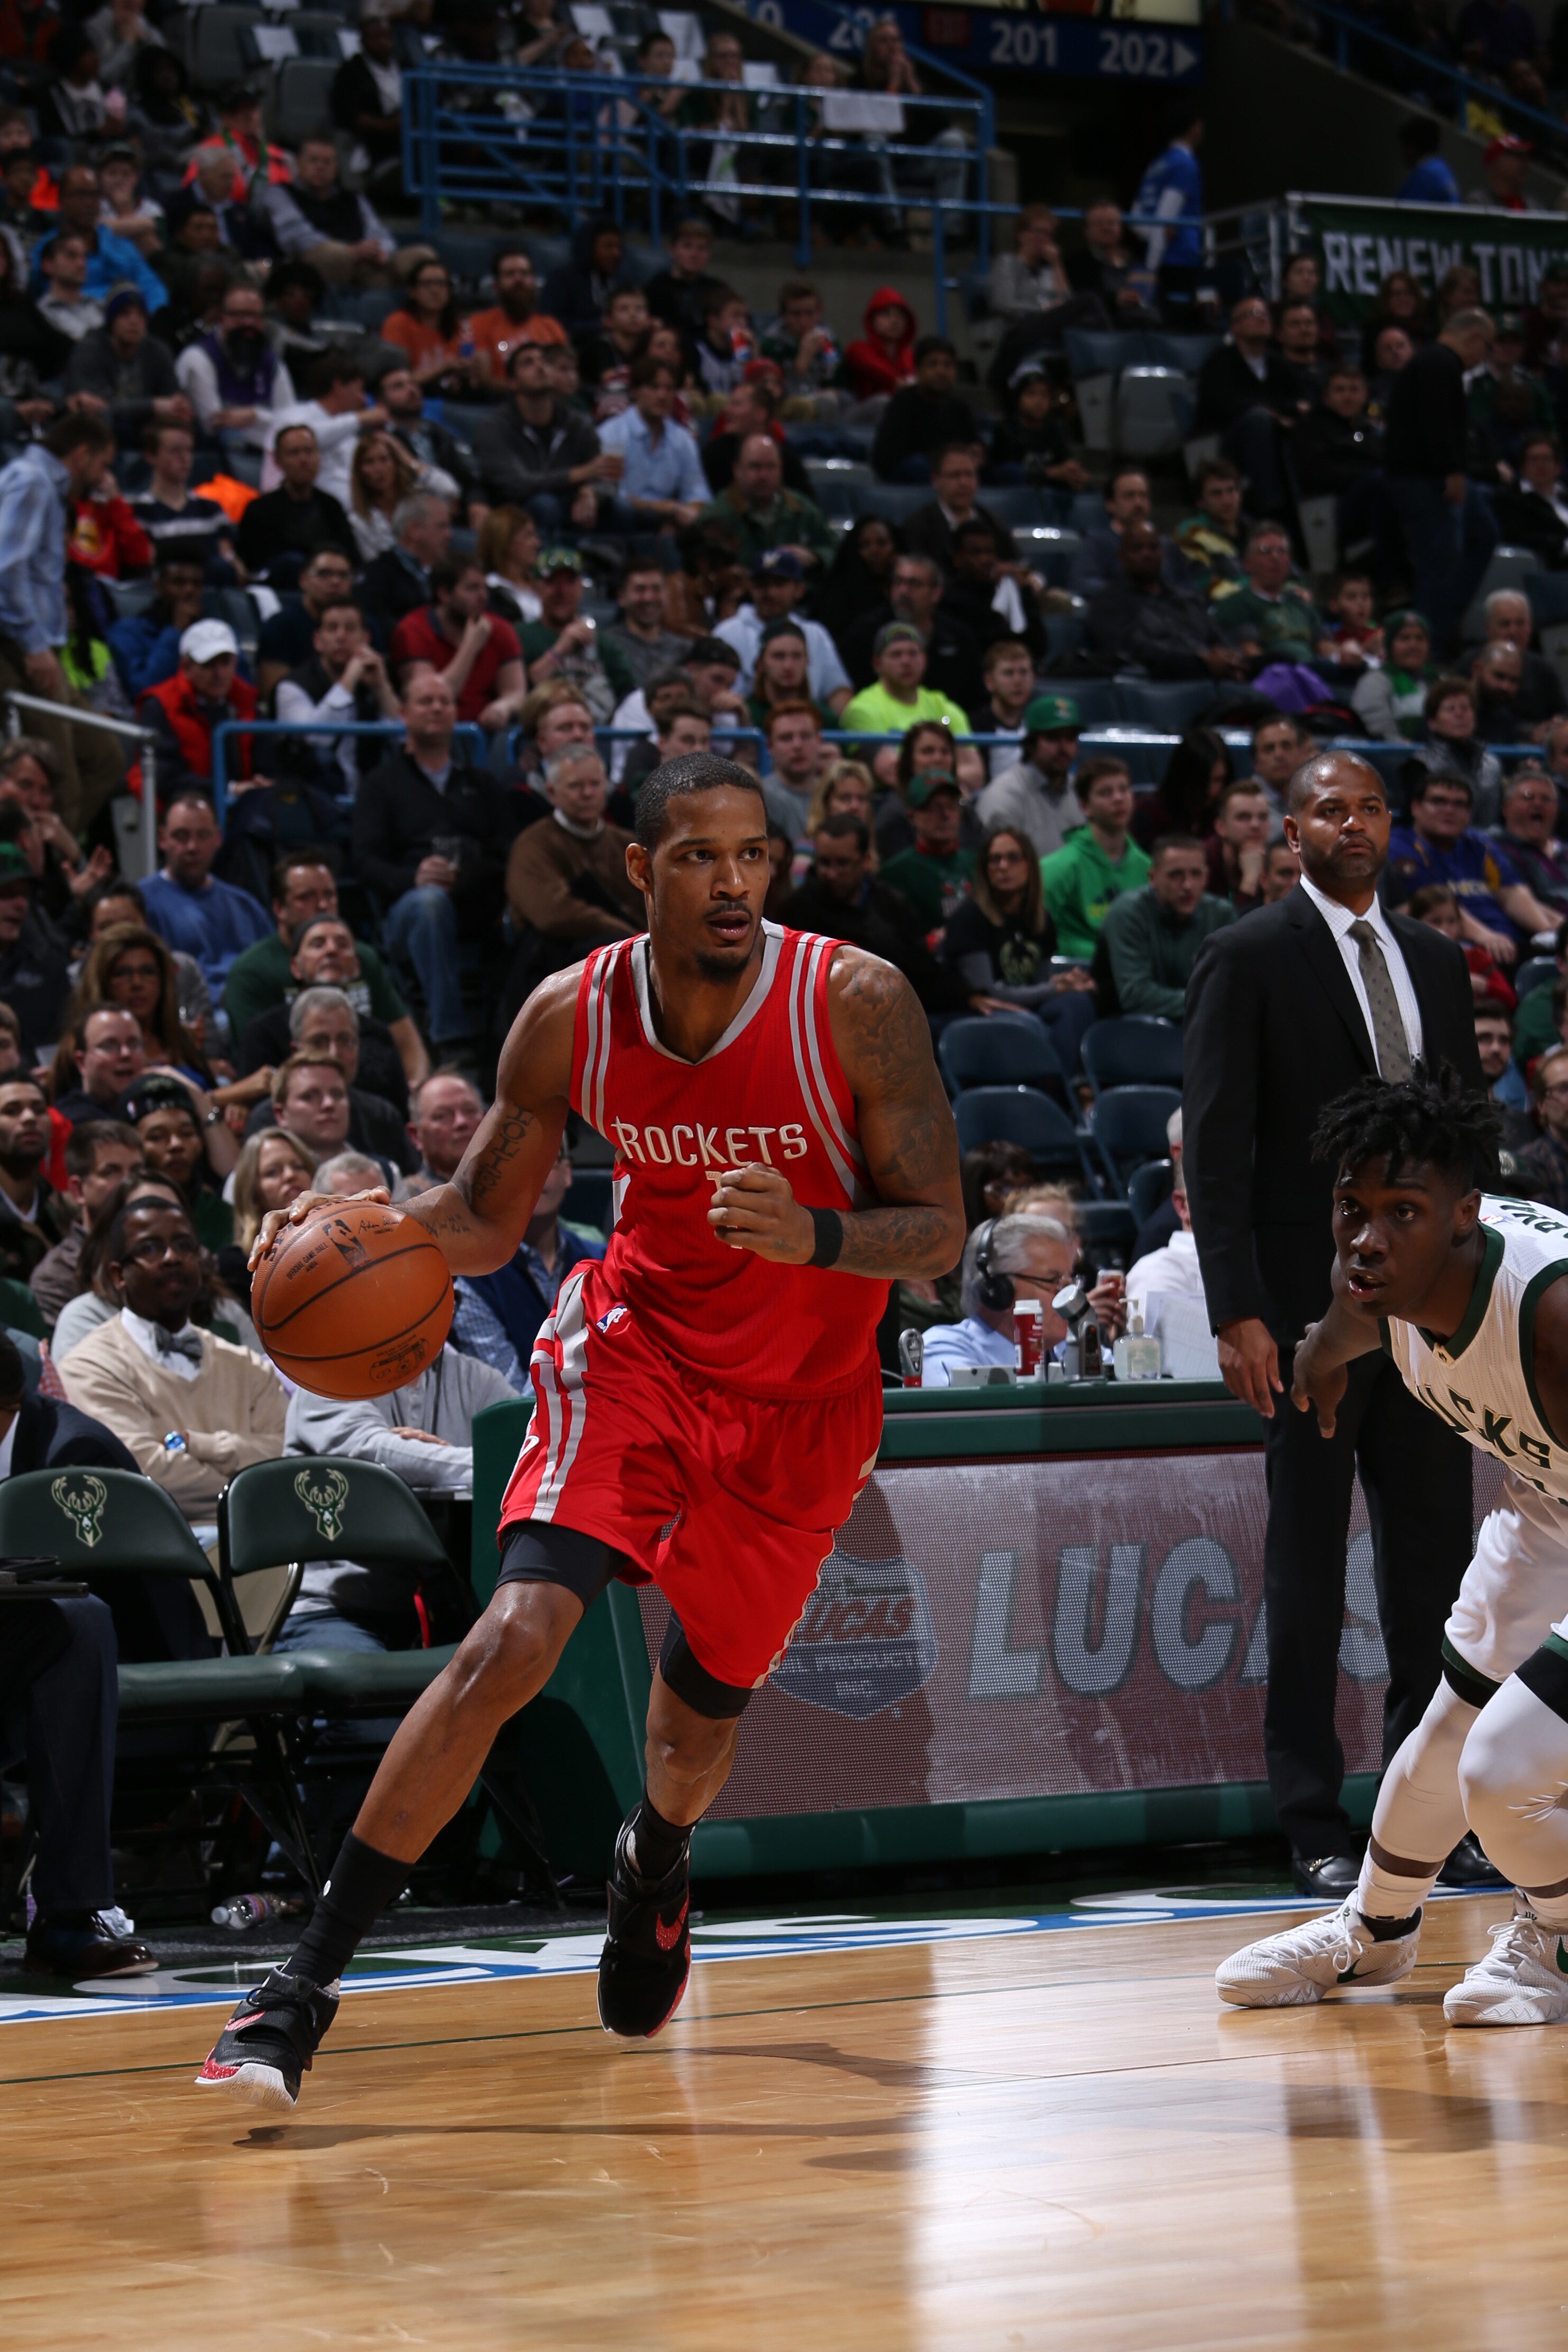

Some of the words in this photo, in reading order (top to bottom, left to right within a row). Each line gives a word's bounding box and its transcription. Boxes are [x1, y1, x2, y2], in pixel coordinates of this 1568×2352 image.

[989, 17, 1057, 68] 201
[1098, 27, 1169, 78] 202
[1322, 231, 1464, 299] RENEW
[1470, 240, 1568, 305] TON
[610, 1116, 808, 1167] ROCKETS
[302, 1250, 316, 1264] GAME
[315, 1242, 328, 1253] BALL
[793, 1596, 917, 1643] UCAS
